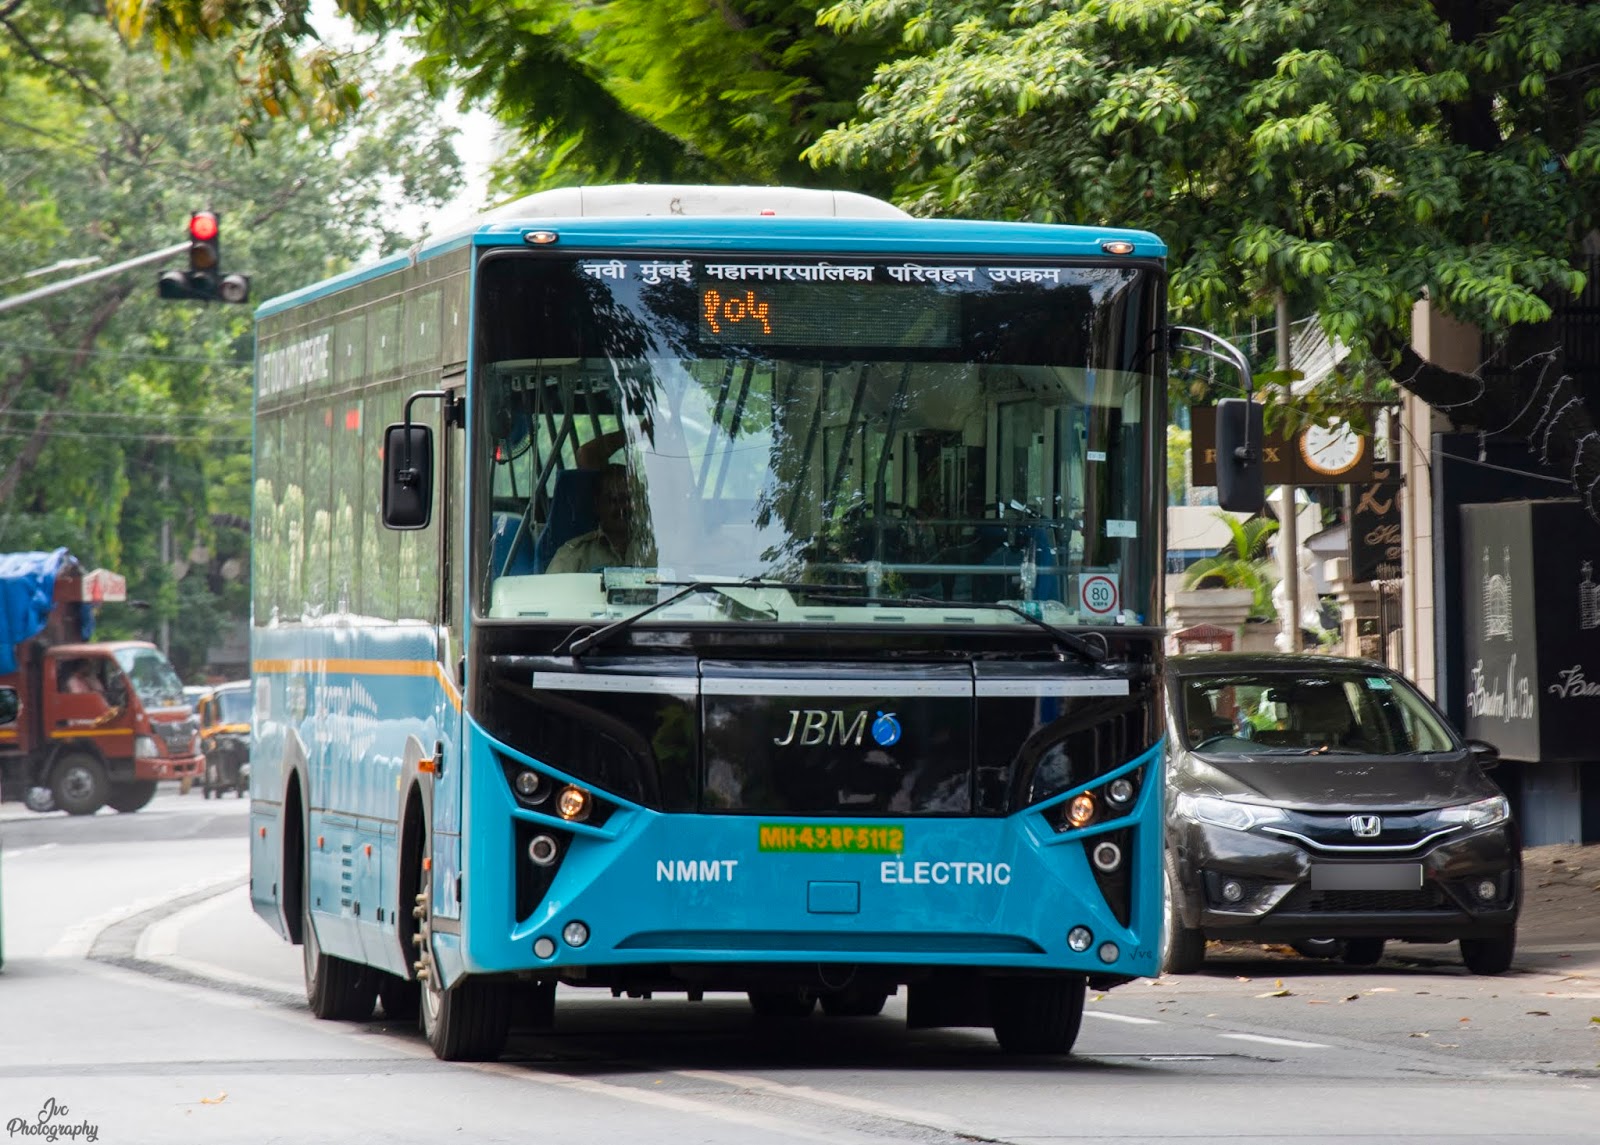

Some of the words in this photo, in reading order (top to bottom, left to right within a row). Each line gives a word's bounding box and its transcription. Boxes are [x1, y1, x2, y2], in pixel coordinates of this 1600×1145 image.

[583, 260, 627, 279] नवी
[640, 260, 693, 284] मुंबई
[705, 262, 874, 281] महानगरपालिका
[887, 263, 976, 282] परिवहन
[988, 267, 1061, 283] उपक्रम
[1092, 587, 1109, 601] 80
[773, 710, 868, 746] JBM
[656, 860, 738, 882] NMMT
[880, 861, 1012, 885] ELECTRIC
